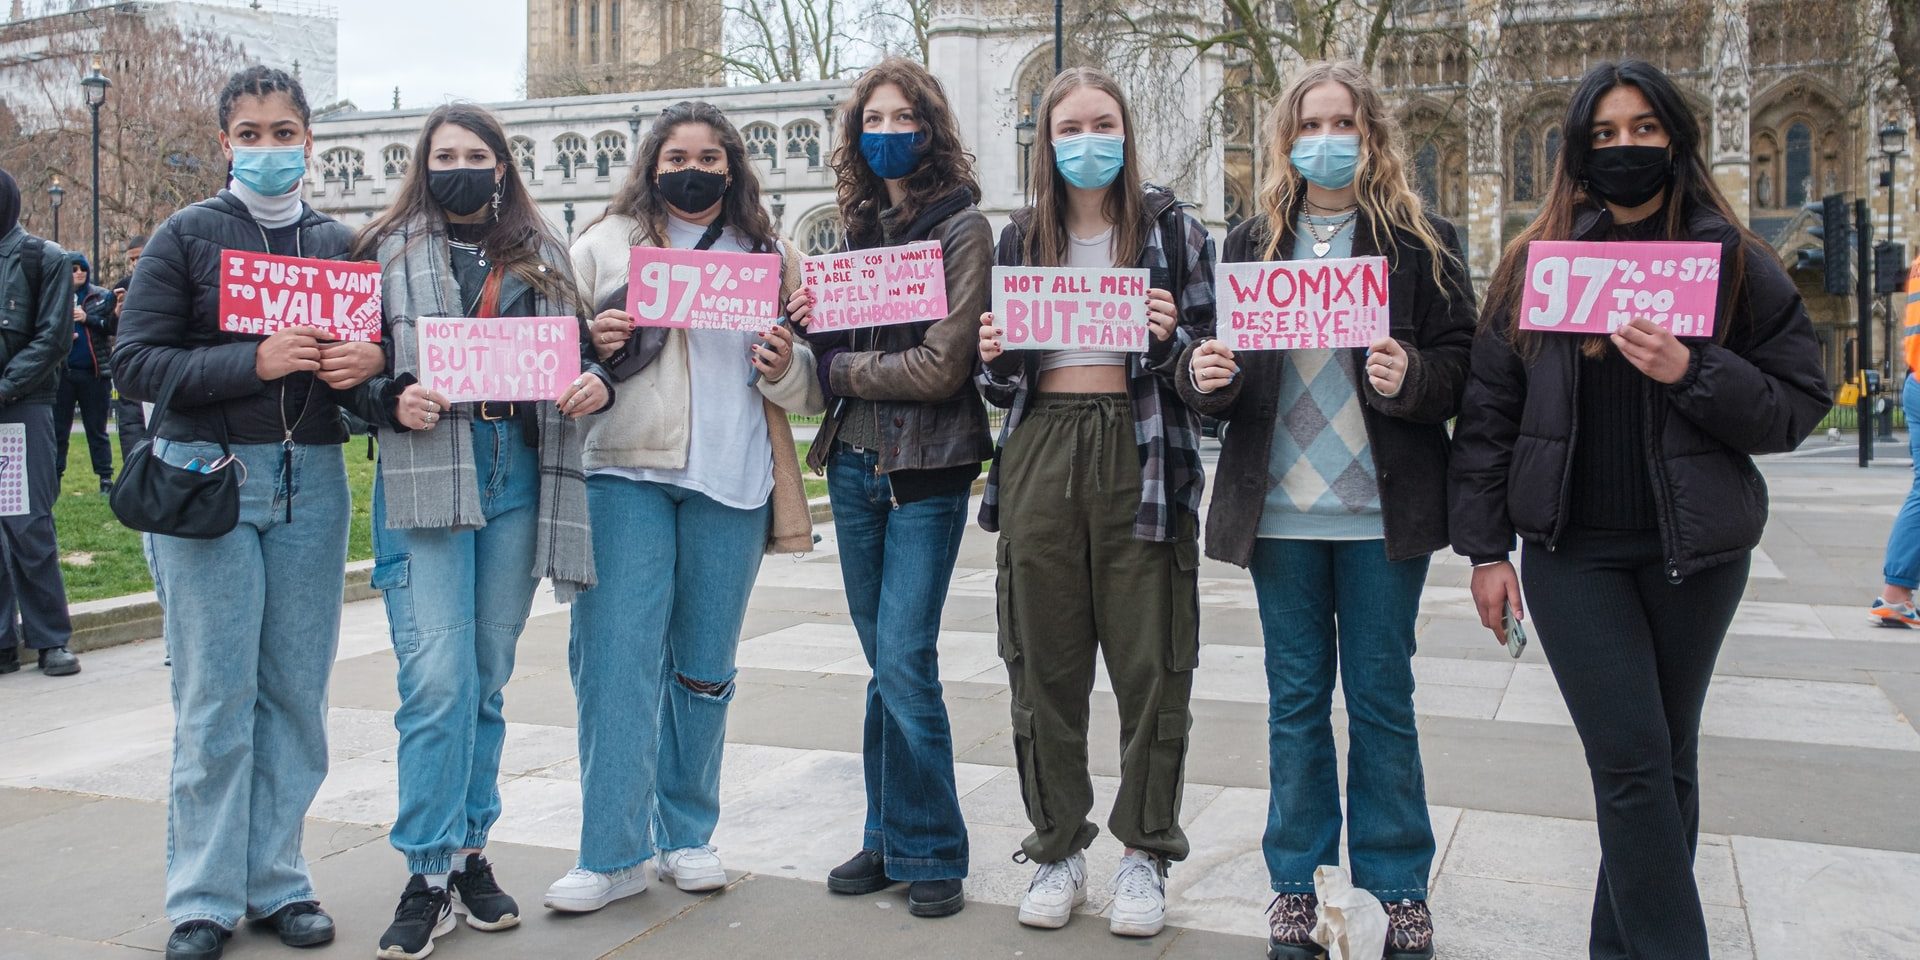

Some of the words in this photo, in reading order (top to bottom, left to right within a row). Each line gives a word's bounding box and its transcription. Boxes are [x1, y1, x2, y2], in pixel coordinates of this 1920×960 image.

[833, 257, 856, 270] HERE
[890, 253, 895, 263] I
[901, 249, 927, 261] WANT
[929, 247, 943, 259] TO
[229, 257, 245, 277] I
[252, 260, 319, 288] JUST
[325, 269, 382, 294] WANT
[739, 267, 769, 283] OF
[807, 276, 818, 286] BE
[824, 271, 852, 283] ABLE
[861, 269, 875, 279] TO
[884, 261, 934, 283] WALK
[1229, 259, 1388, 311] WOMXN
[888, 288, 900, 296] IN
[907, 282, 925, 295] MY
[1004, 275, 1043, 293] NOT
[1052, 276, 1091, 293] ALL
[1100, 276, 1143, 296] MEN
[228, 284, 256, 300] TO
[260, 287, 355, 330] WALK
[700, 293, 773, 316] WOMXN
[1612, 288, 1675, 312] TOO
[690, 320, 735, 330] SEXUAL
[691, 310, 719, 321] HAVE
[1006, 299, 1078, 344] BUT
[1086, 301, 1131, 320] TOO
[337, 328, 371, 341] THE
[425, 323, 464, 339] NOT
[467, 324, 513, 340] ALL
[517, 323, 566, 343] MEN
[1078, 324, 1146, 347] MANY
[427, 344, 490, 372] BUT
[495, 347, 559, 376] TOO
